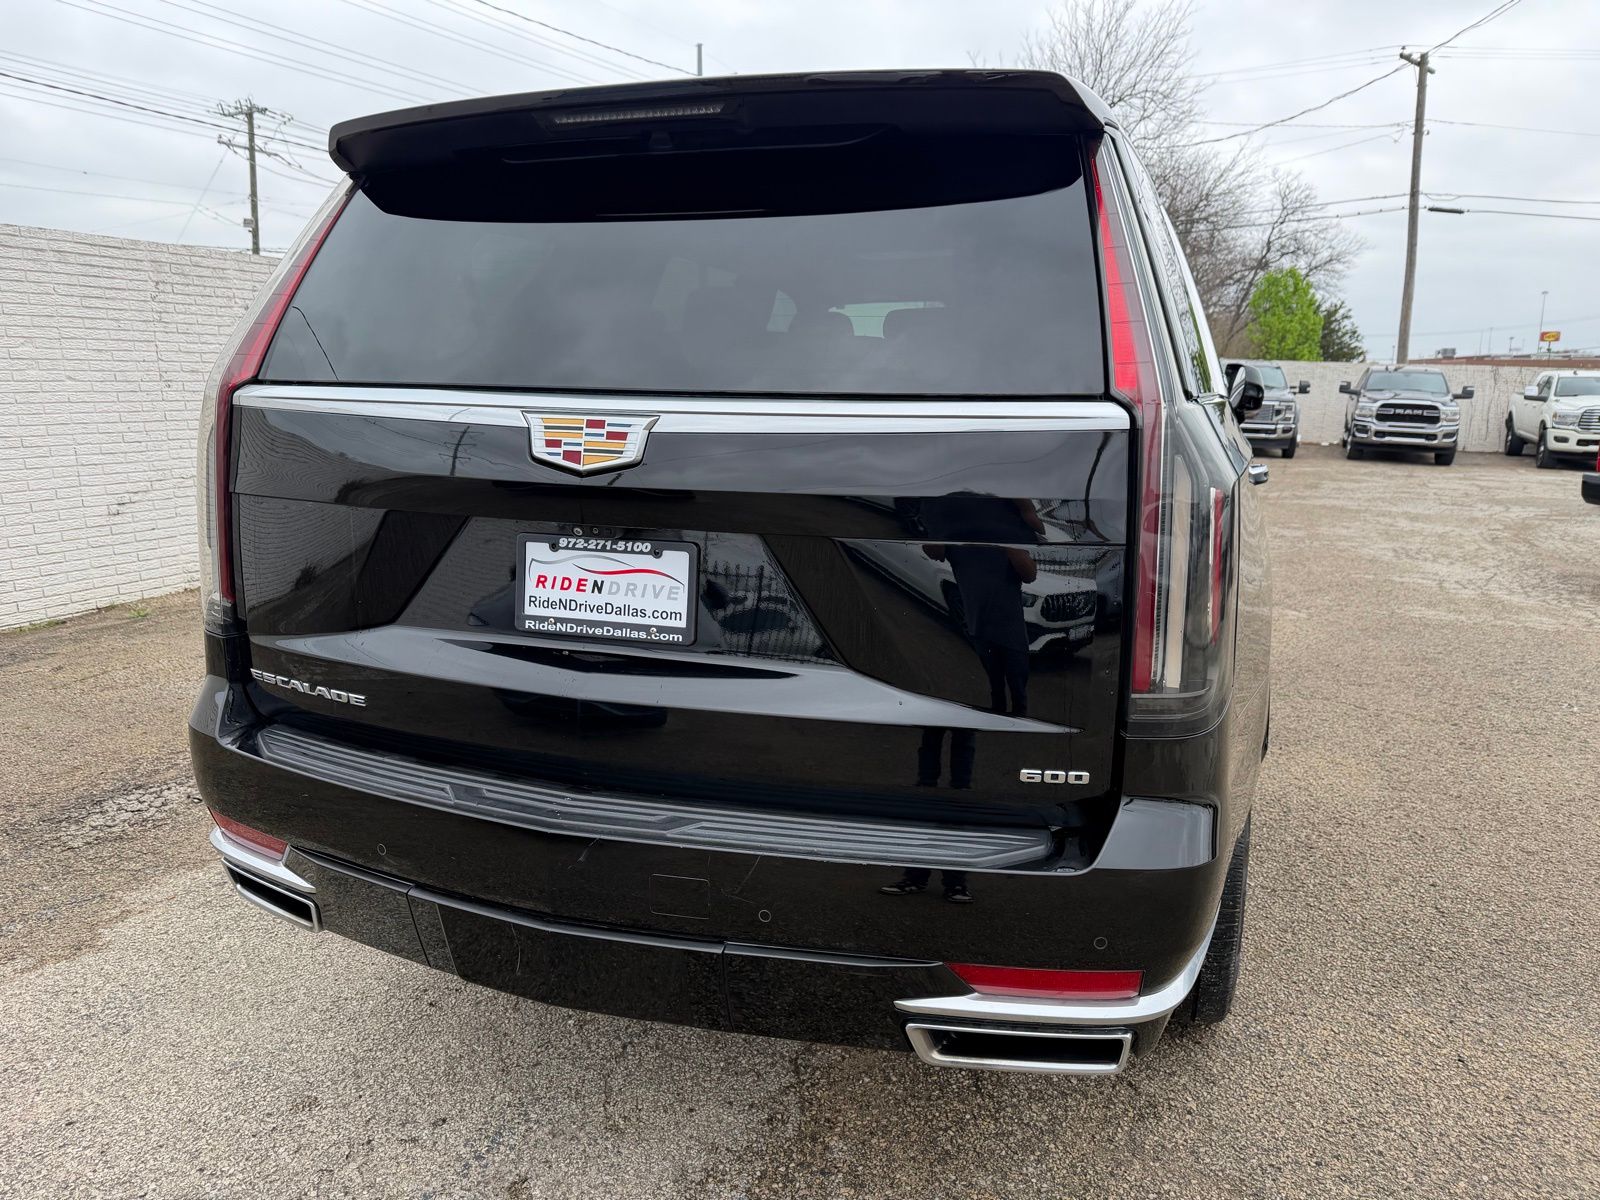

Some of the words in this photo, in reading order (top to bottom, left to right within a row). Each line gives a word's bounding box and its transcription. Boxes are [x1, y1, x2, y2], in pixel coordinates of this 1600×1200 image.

[558, 537, 652, 553] 972-271-5100
[535, 574, 681, 601] RIDENDRIVE
[528, 595, 682, 622] RideNDriveDallas.com
[525, 620, 682, 642] RideNDriveDallas.com
[250, 668, 367, 706] ESCALADE
[1019, 768, 1090, 785] 600
